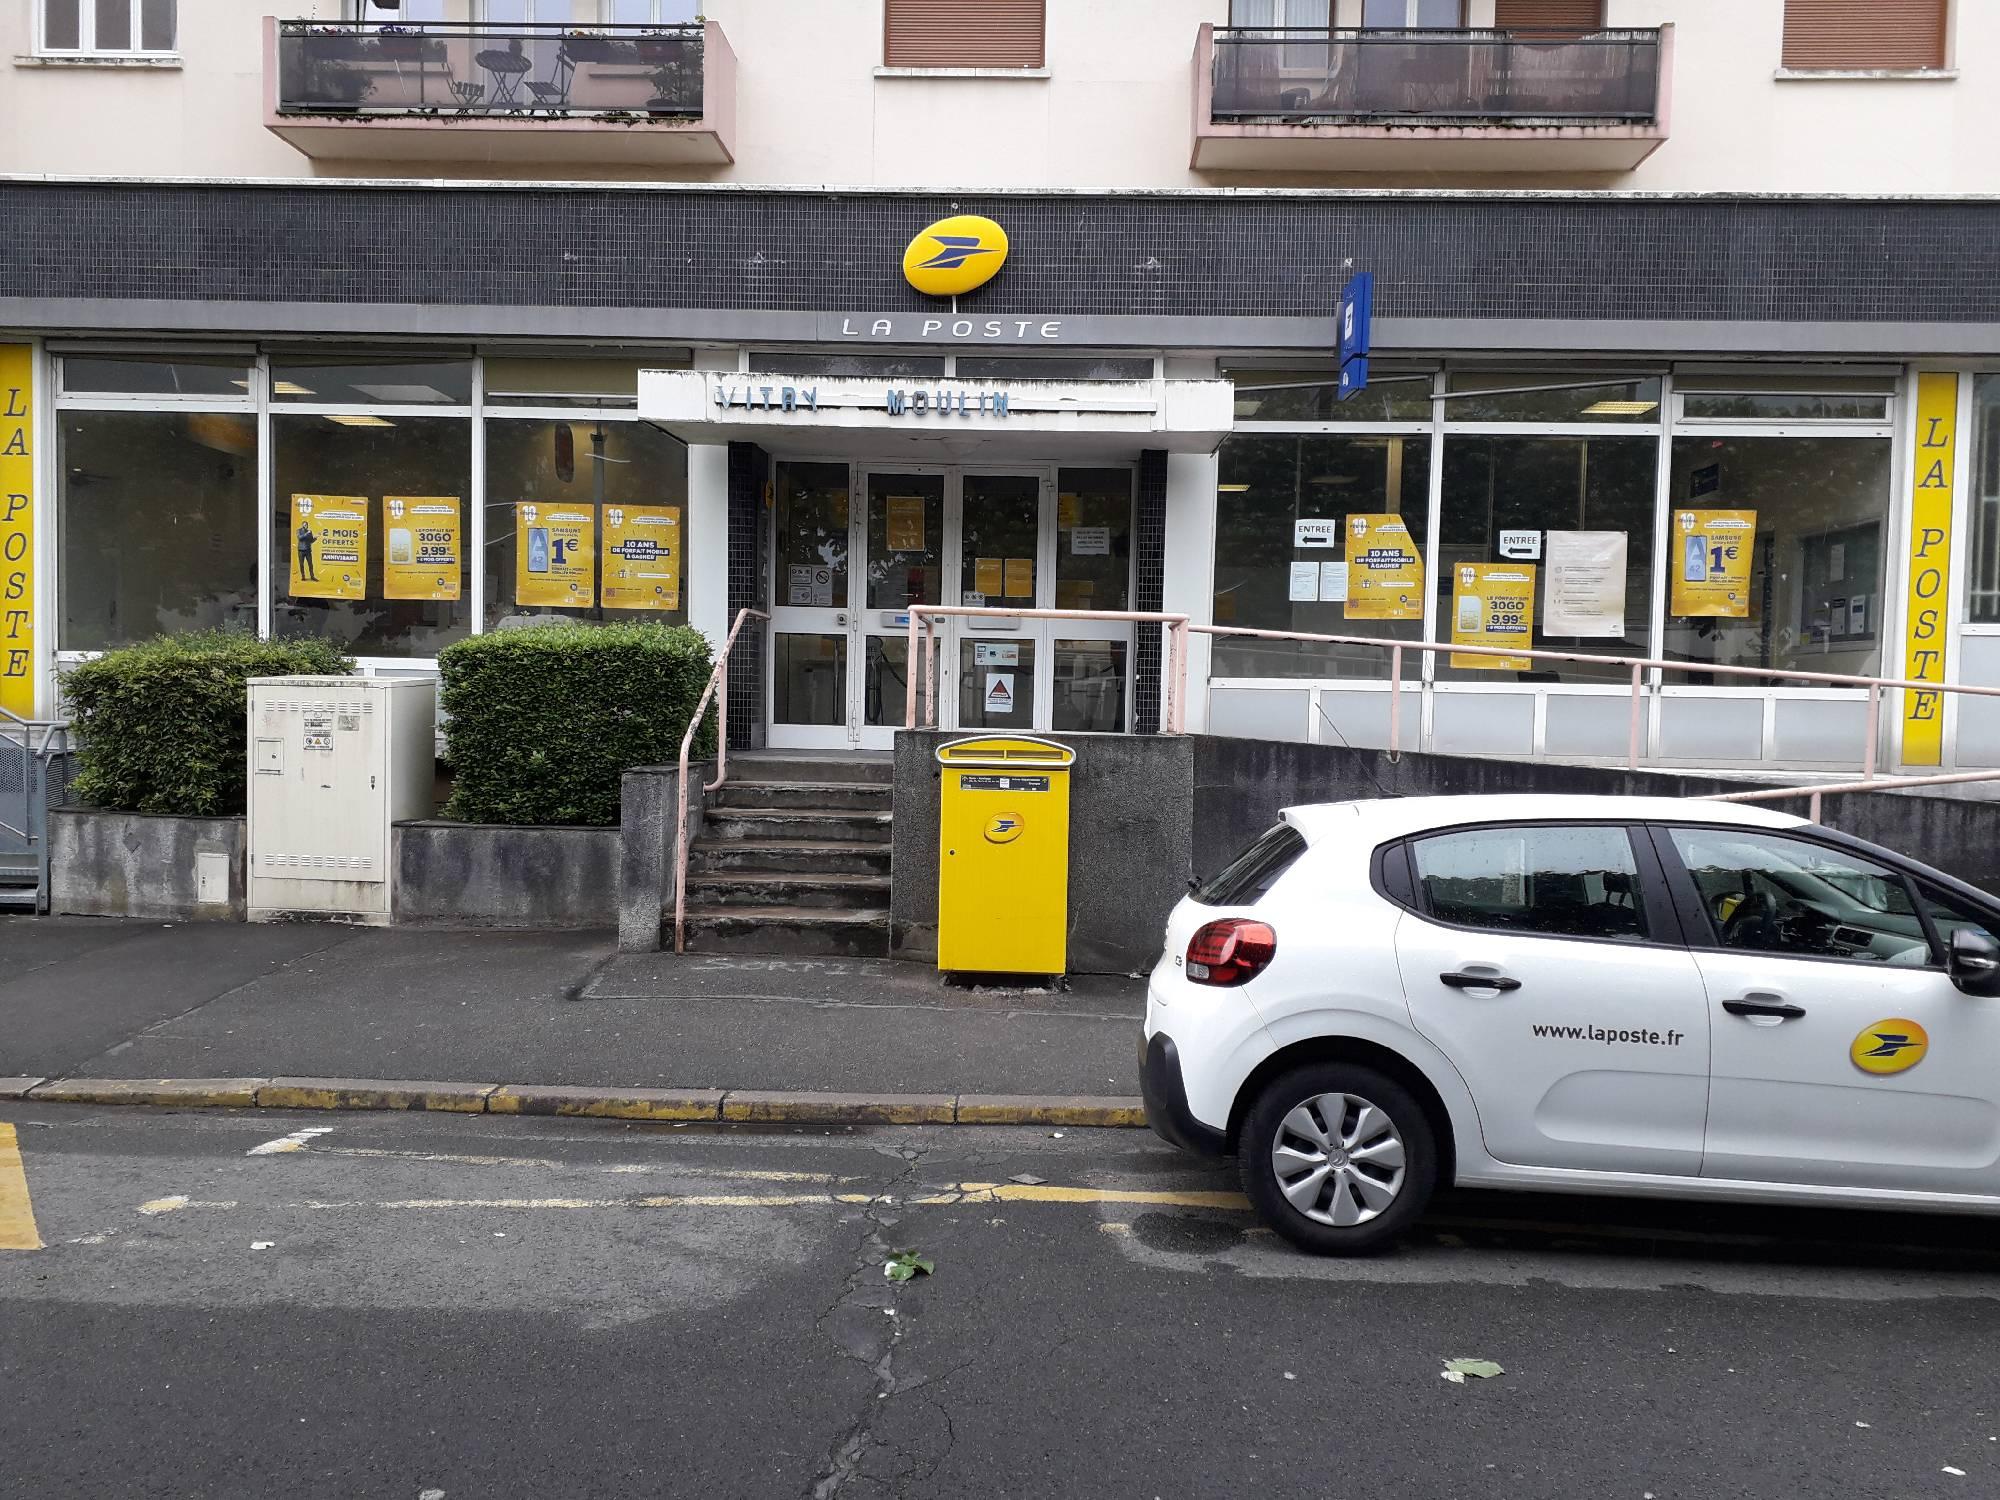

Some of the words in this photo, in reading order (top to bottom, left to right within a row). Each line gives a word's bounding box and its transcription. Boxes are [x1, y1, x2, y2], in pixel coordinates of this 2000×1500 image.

[842, 318, 891, 336] LA
[922, 319, 1062, 338] POSTE
[714, 385, 818, 412] VITRY
[887, 389, 1009, 418] MOULIN
[2, 388, 29, 455] LA
[1918, 418, 1949, 488] LA
[332, 529, 359, 538] MOIS
[419, 533, 451, 542] 30GO
[1298, 525, 1331, 533] ENTREE
[1503, 536, 1537, 544] ENTREE
[552, 538, 578, 564] 1€
[1710, 545, 1739, 573] 1€
[2, 494, 28, 677] POSTE
[1490, 601, 1525, 610] 30GO
[1908, 528, 1945, 720] POSTE
[1532, 1023, 1684, 1046] www.laposte.fr
